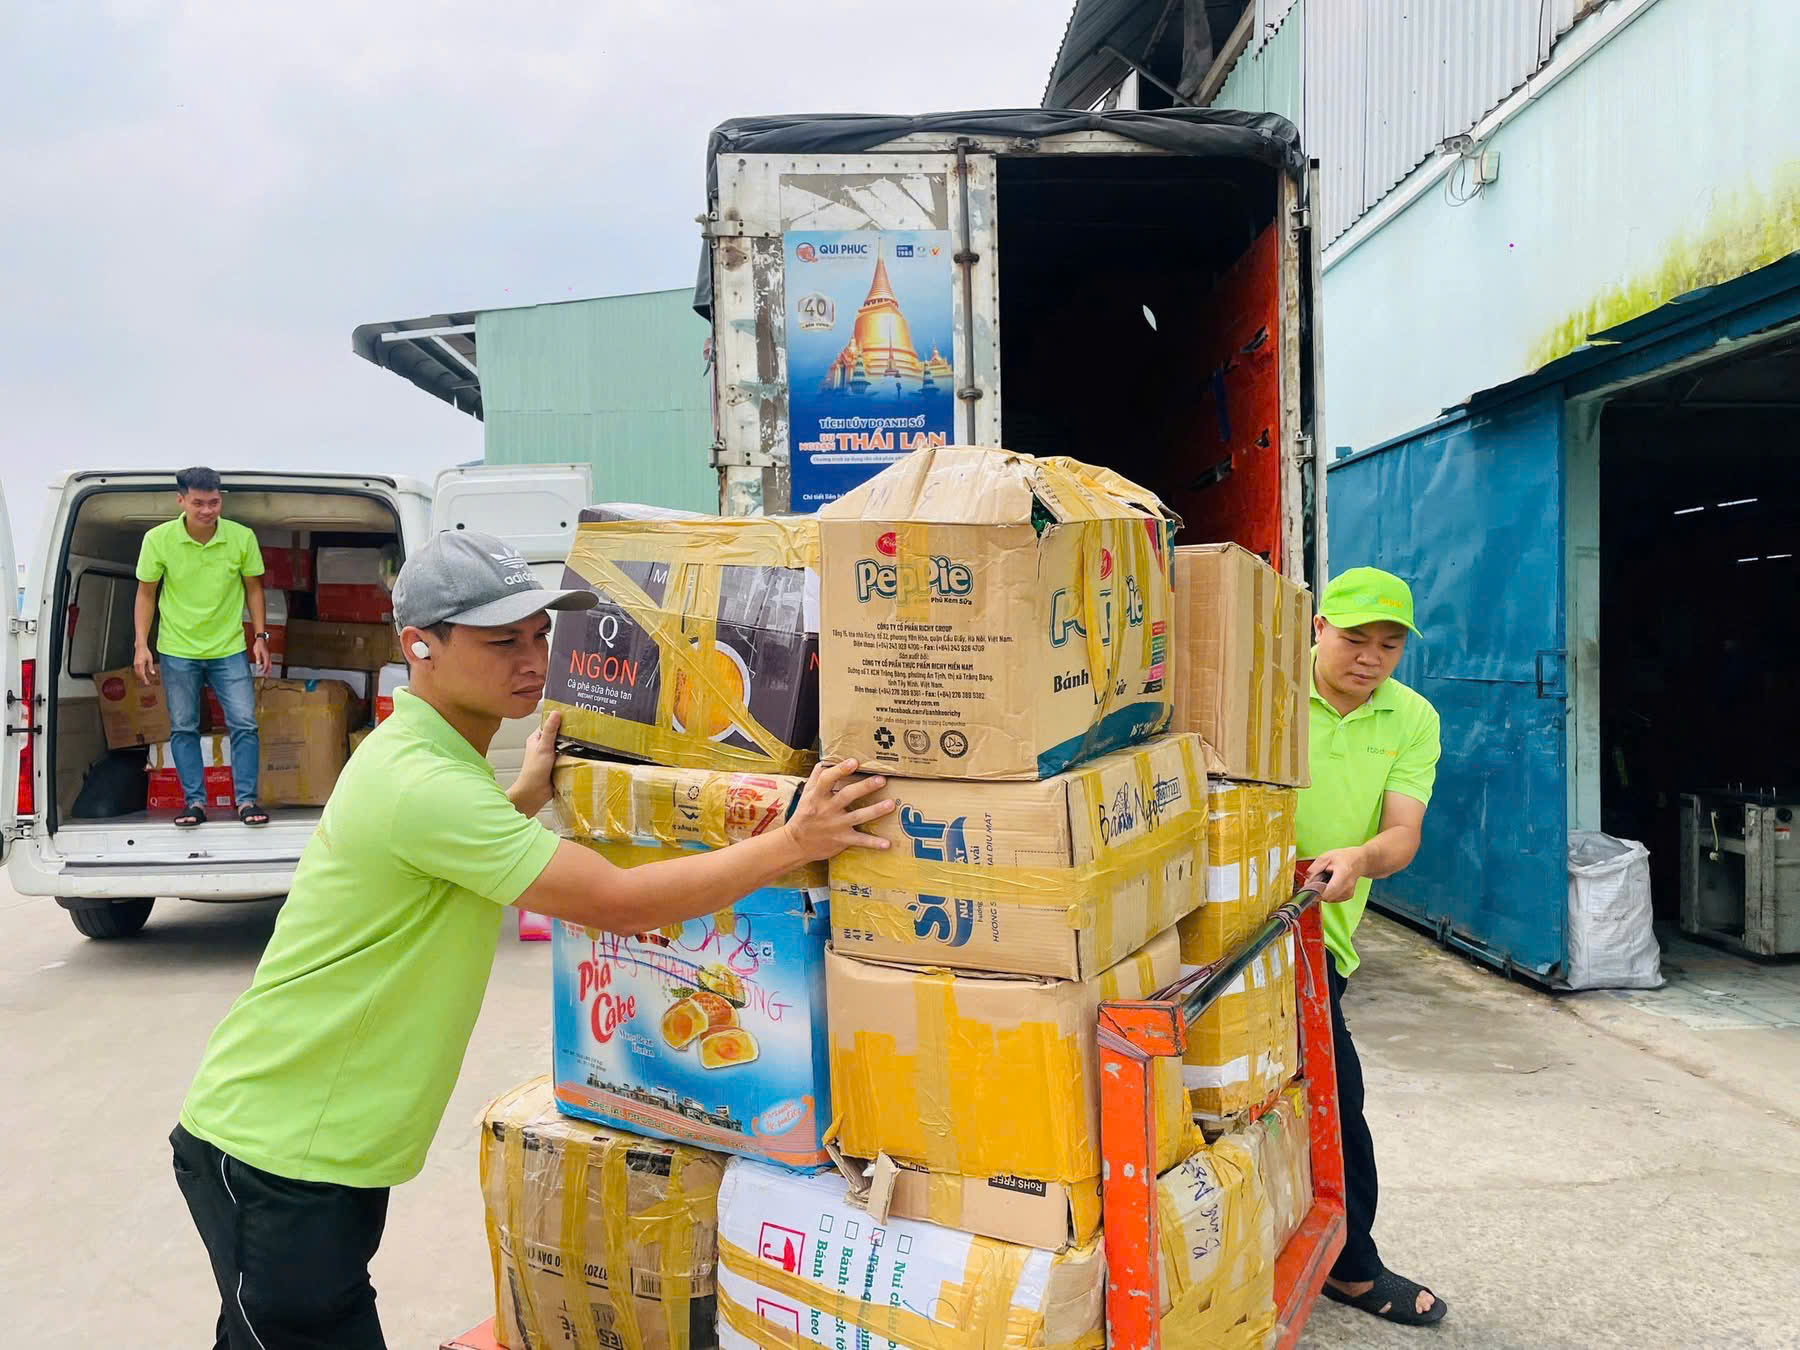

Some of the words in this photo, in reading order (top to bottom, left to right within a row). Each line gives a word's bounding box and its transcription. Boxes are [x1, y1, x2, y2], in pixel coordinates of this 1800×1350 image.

[819, 243, 839, 254] QUI
[841, 243, 868, 254] PHUC
[804, 299, 827, 316] 40
[819, 416, 844, 429] TÍCH
[868, 416, 907, 428] DOANH
[909, 414, 925, 428] SỐ
[836, 428, 894, 450] THÁI
[900, 432, 946, 450] LAN
[960, 598, 972, 606] Sữa
[599, 615, 618, 648] Q
[876, 622, 890, 630] CÔNG
[918, 624, 934, 632] RICHY
[570, 649, 638, 687] NGON
[862, 658, 874, 666] CÔNG
[902, 661, 916, 670] THỰC
[932, 662, 946, 670] RICHY
[567, 678, 576, 688] Cà
[576, 680, 590, 692] phê
[590, 684, 604, 694] sữa
[620, 690, 632, 700] tan
[1053, 668, 1089, 694] Bánh
[894, 698, 940, 707] www.richy.com.vn
[924, 690, 936, 698] Fax:
[577, 959, 612, 1002] Pia
[591, 992, 636, 1044] Cake
[587, 1099, 625, 1120] SPECIAL
[1018, 1178, 1042, 1192] RoHS
[812, 1238, 830, 1278] Bánh
[837, 1246, 856, 1285] Bánh
[890, 1260, 906, 1288] Nui
